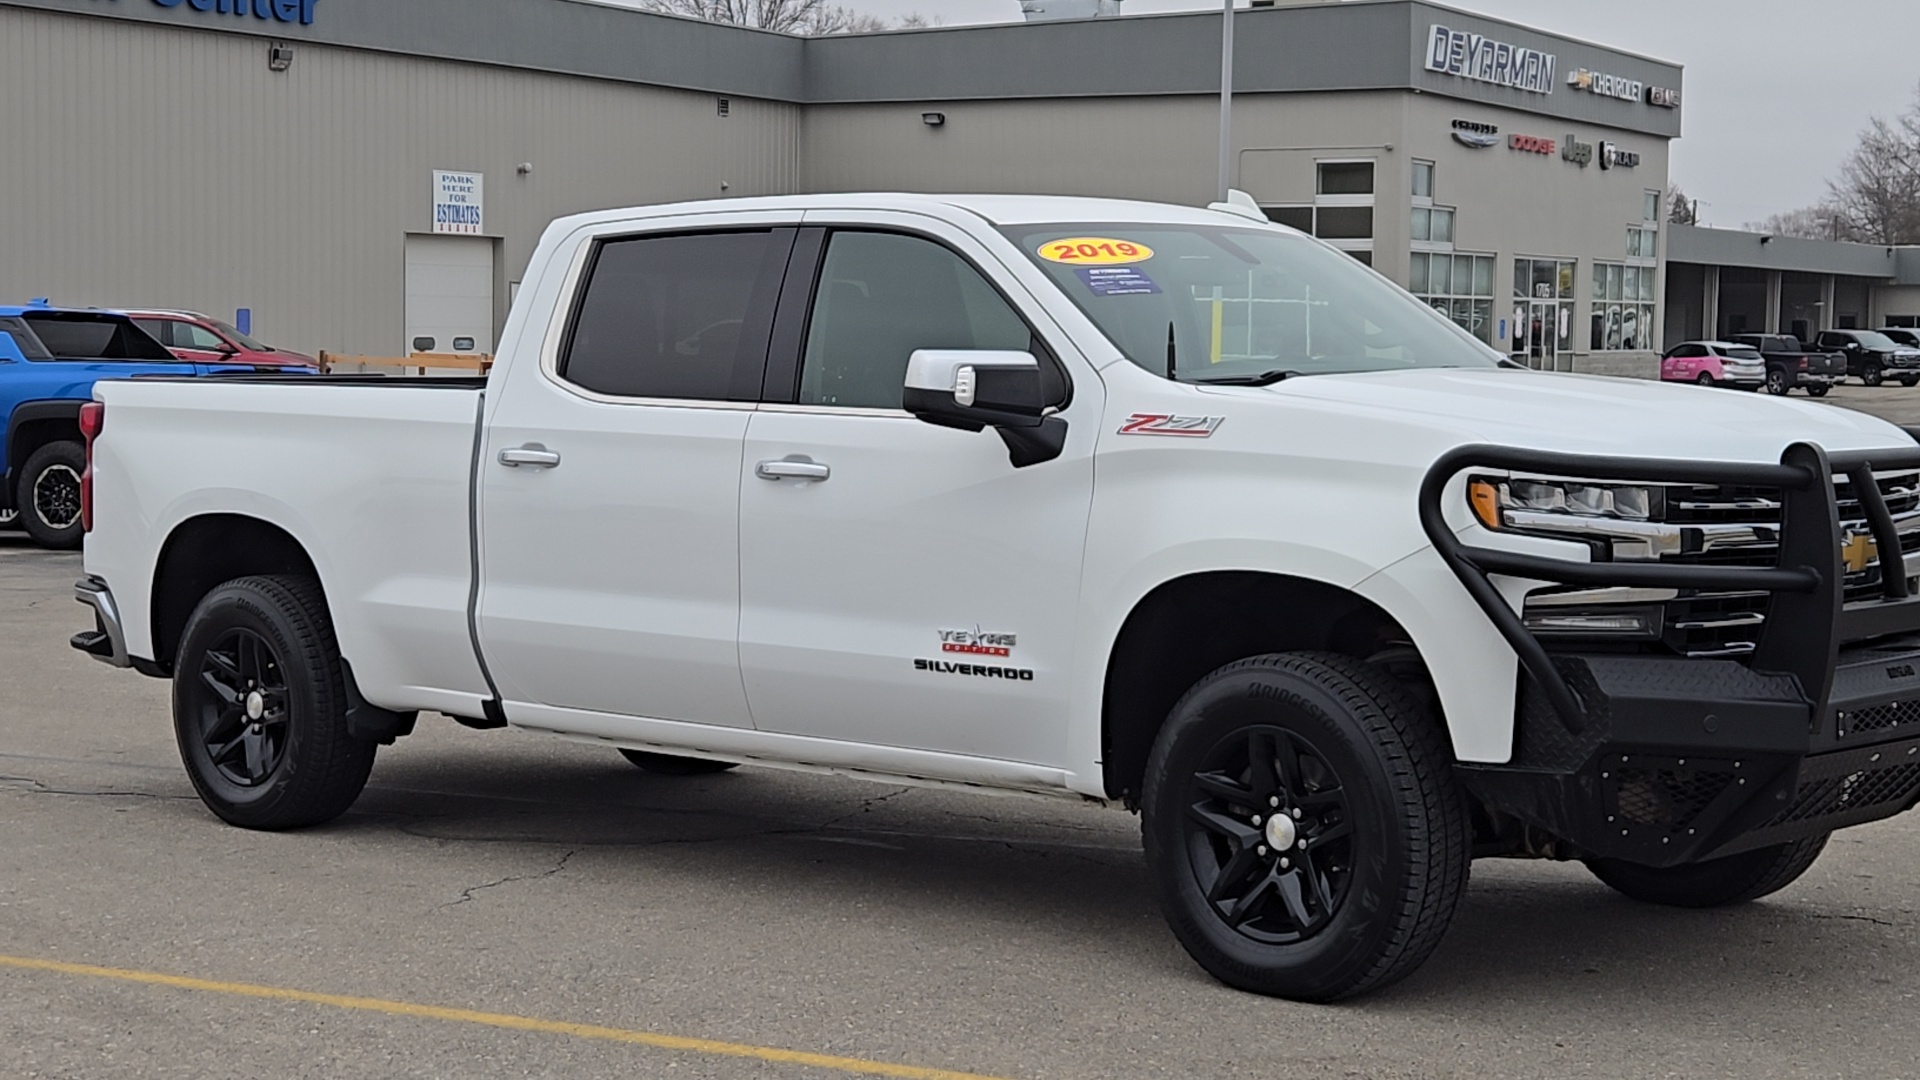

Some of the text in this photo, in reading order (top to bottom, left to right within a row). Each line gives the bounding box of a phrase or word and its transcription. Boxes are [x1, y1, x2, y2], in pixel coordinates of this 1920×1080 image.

[1425, 24, 1556, 94] DEYARMAN
[1593, 71, 1643, 102] CHEVROLET
[1510, 134, 1556, 156] DODGE
[1562, 134, 1592, 168] Jeep
[442, 174, 475, 184] PARK
[442, 184, 475, 193] HERE
[449, 193, 467, 203] FOR
[436, 203, 481, 225] ESTIMATES
[1053, 242, 1140, 260] 2019
[1535, 282, 1550, 298] 1705
[1117, 413, 1226, 439] Z71
[937, 623, 1017, 647] TEXAS
[944, 644, 1007, 656] EDITION
[913, 658, 1034, 681] SILVERADO
[1246, 681, 1357, 751] BRIDGESTONE
